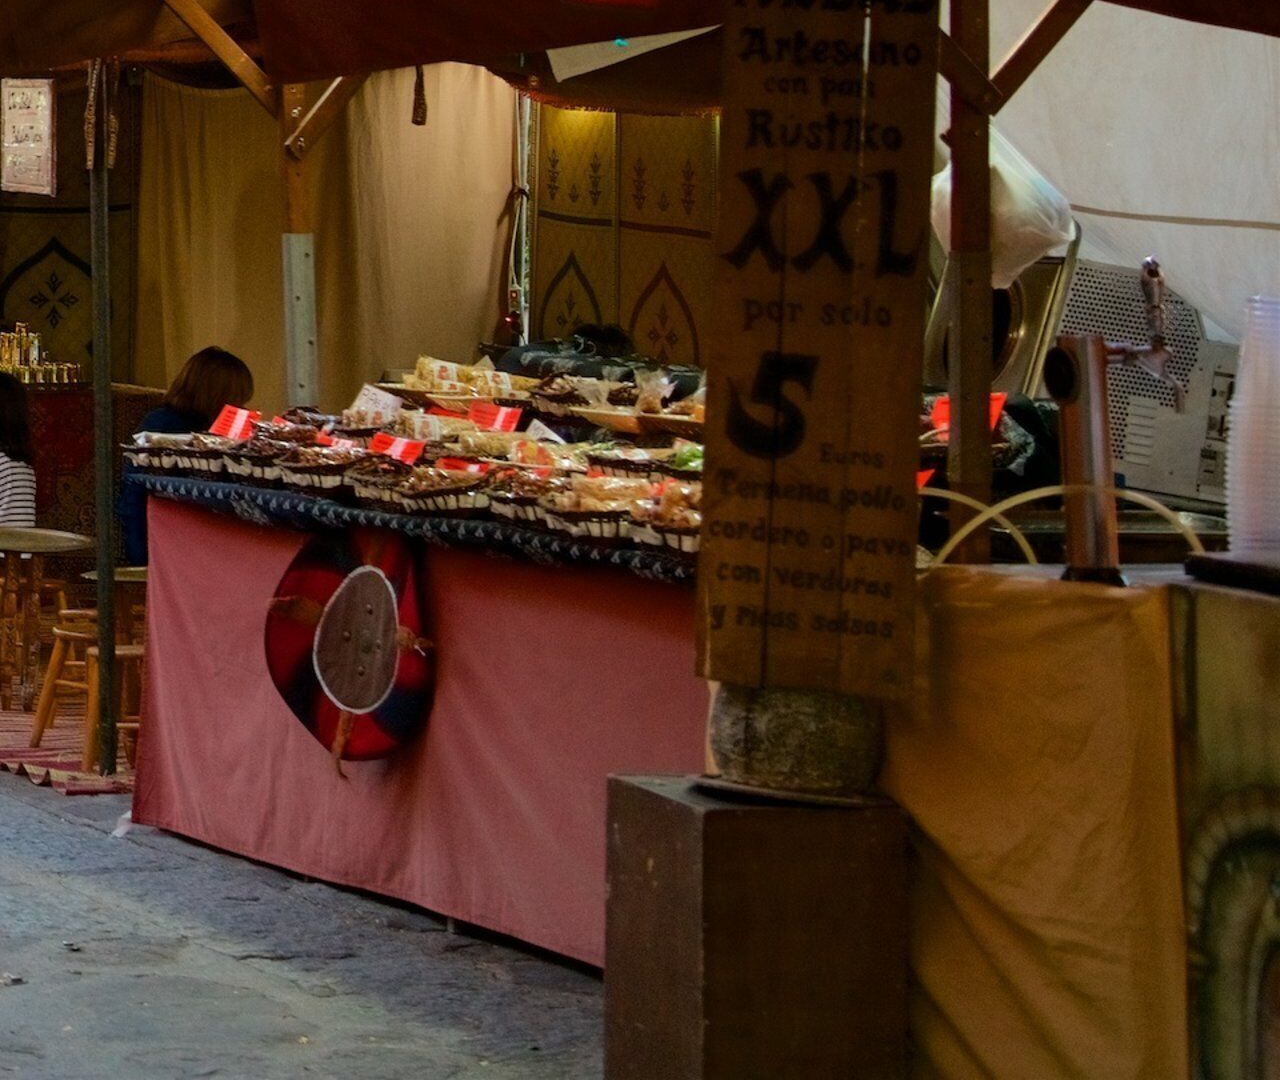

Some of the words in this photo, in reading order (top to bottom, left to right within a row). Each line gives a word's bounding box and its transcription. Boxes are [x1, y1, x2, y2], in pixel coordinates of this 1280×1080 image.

[720, 169, 926, 278] XXL
[743, 298, 803, 332] por
[820, 296, 892, 327] solo
[725, 350, 820, 461] 5
[839, 485, 906, 514] pollo
[709, 517, 810, 548] cordero
[821, 534, 835, 549] o
[847, 533, 912, 559] pavo
[717, 562, 760, 584] con
[772, 566, 893, 599] verduras
